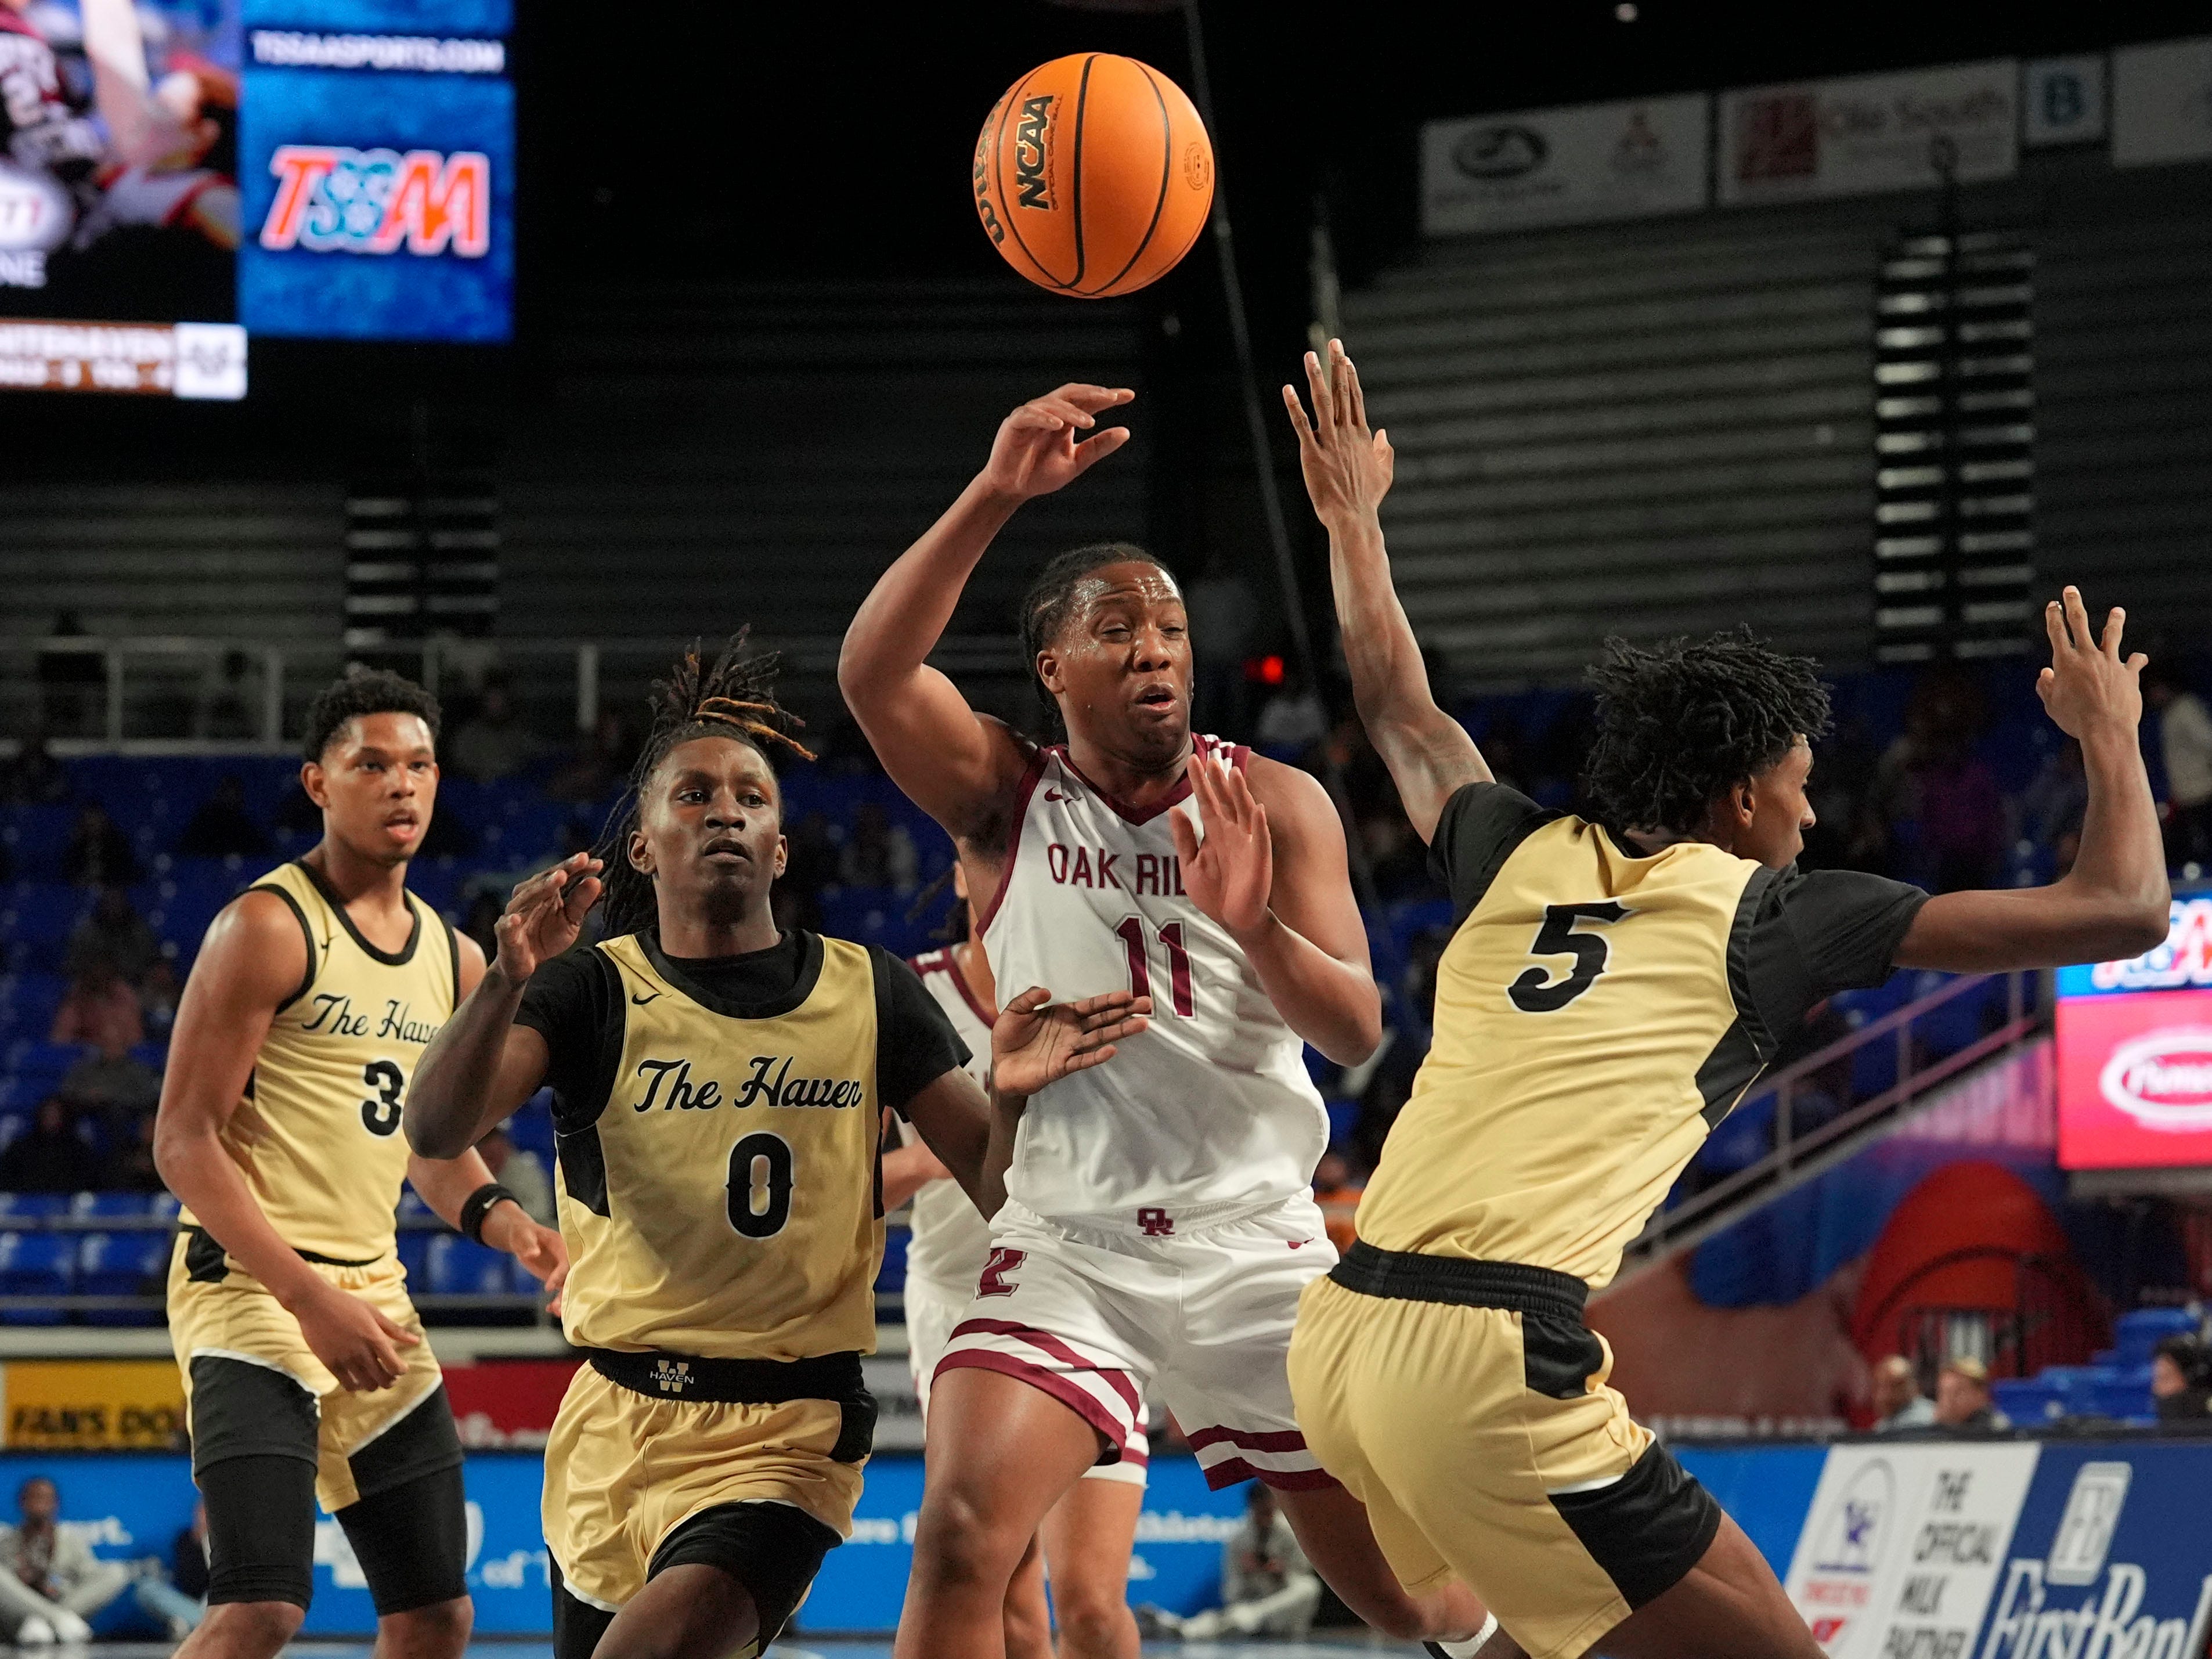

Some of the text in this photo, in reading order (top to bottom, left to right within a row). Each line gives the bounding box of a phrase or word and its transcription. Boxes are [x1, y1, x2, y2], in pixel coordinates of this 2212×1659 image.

[1053, 95, 1062, 121] BALL
[1016, 95, 1053, 211] NCAA
[1048, 157, 1059, 211] OFFICIAL
[1047, 843, 1121, 889] OAK
[1112, 913, 1198, 1021] 11
[1507, 897, 1640, 1013] 5
[301, 993, 440, 1044] The Hav
[361, 1059, 405, 1137] 3
[633, 1055, 863, 1113] The Haven
[724, 1131, 796, 1239] 0
[649, 1371, 694, 1384] HAVEN
[1932, 1469, 1975, 1512] THE
[1913, 1521, 1998, 1565] OFFICIAL
